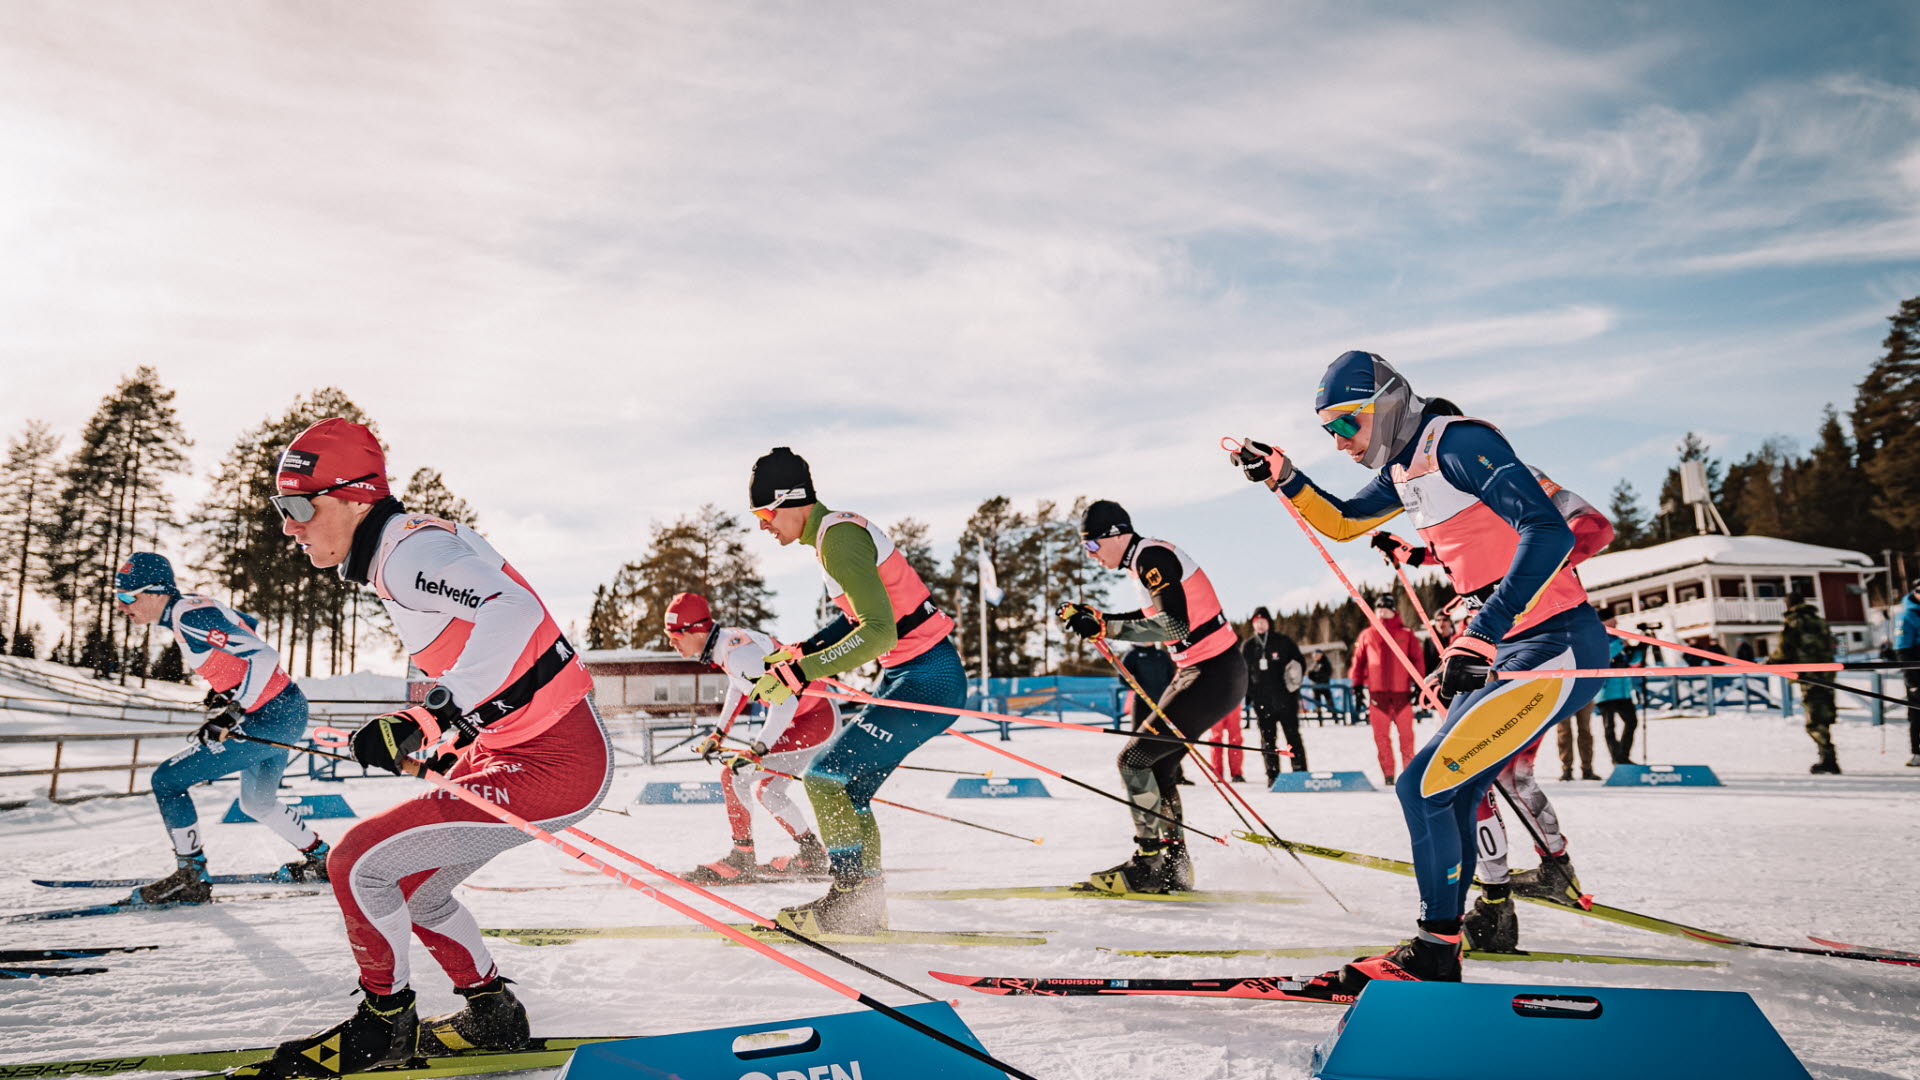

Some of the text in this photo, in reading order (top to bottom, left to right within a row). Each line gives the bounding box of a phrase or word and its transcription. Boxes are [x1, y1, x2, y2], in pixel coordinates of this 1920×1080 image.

[415, 571, 481, 608] helvetia
[819, 634, 864, 665] SLOVENIA
[853, 713, 893, 743] HALTI
[1458, 692, 1544, 765] SWEDISH ARMED FORCES
[187, 829, 199, 851] 2
[1477, 826, 1498, 858] 0
[0, 1057, 148, 1079] FISCHER
